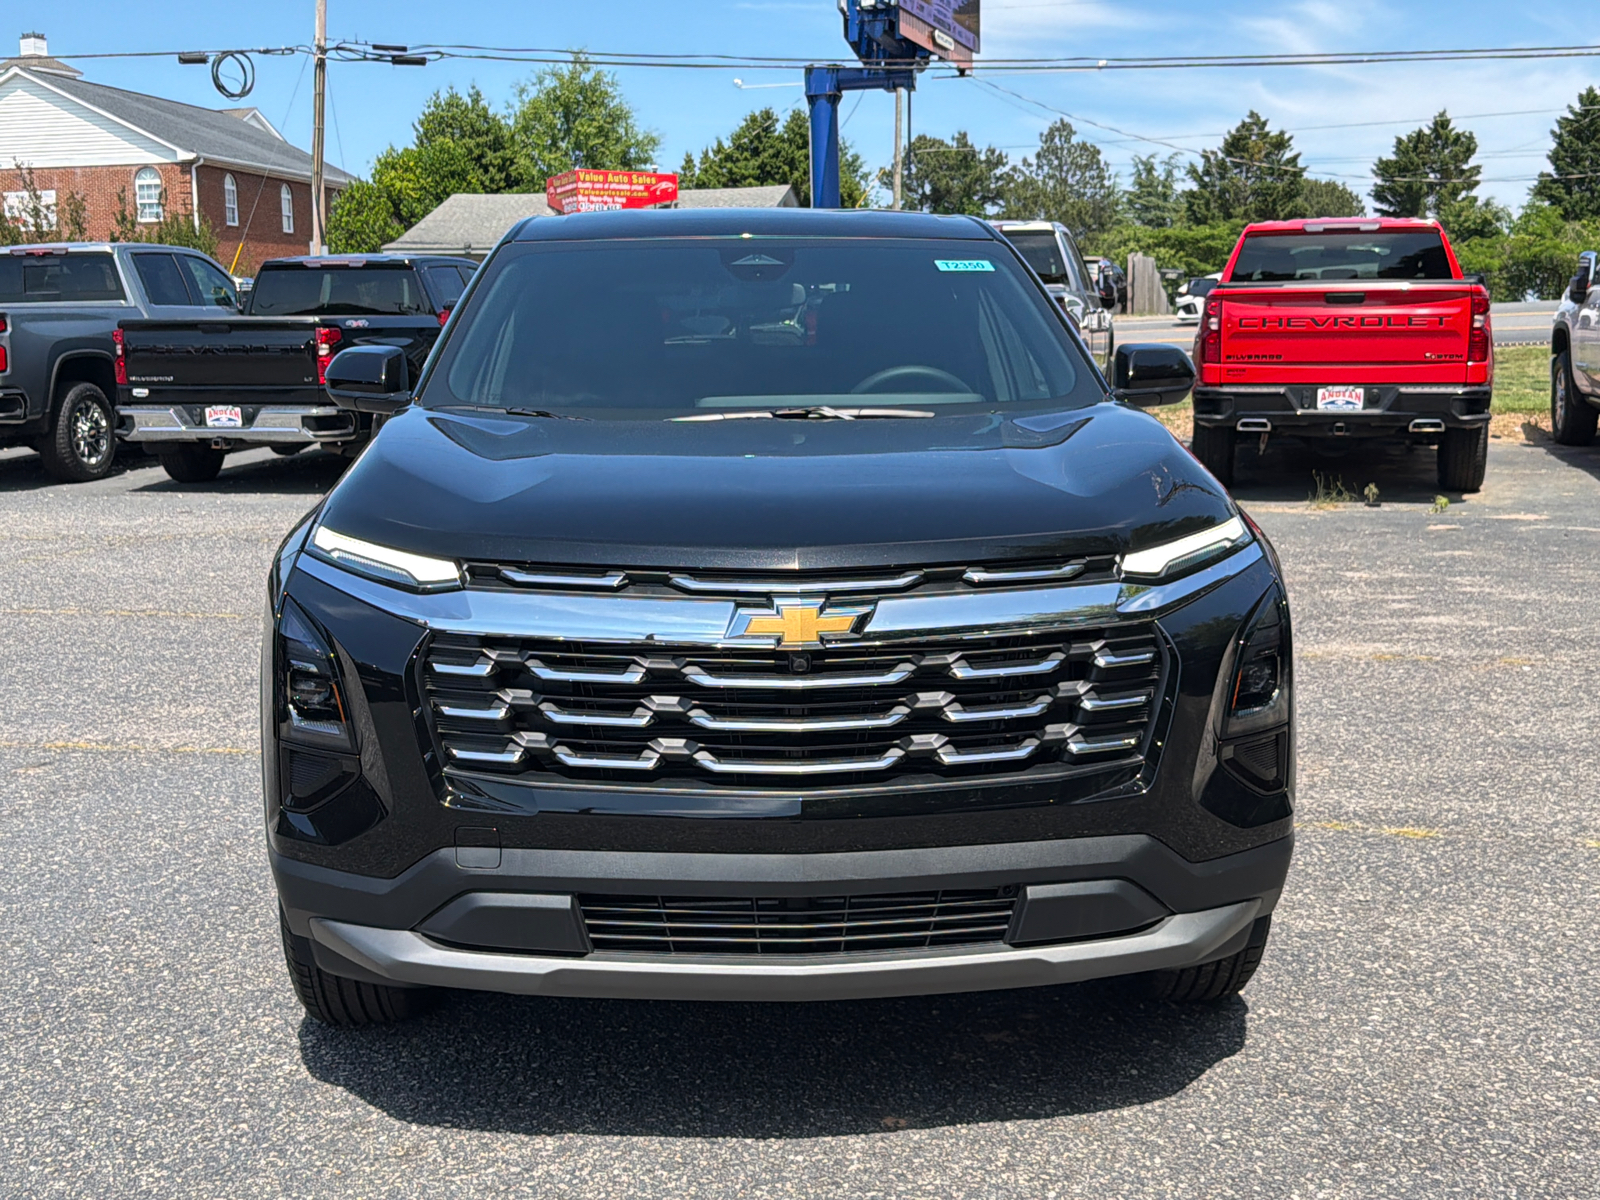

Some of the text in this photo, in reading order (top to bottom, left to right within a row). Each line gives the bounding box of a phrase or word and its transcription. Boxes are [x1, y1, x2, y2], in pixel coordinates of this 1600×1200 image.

[578, 171, 604, 182] Value
[607, 172, 629, 183] Auto
[632, 174, 657, 185] Sales
[941, 261, 985, 269] T2350
[1238, 315, 1452, 329] CHEVROLET
